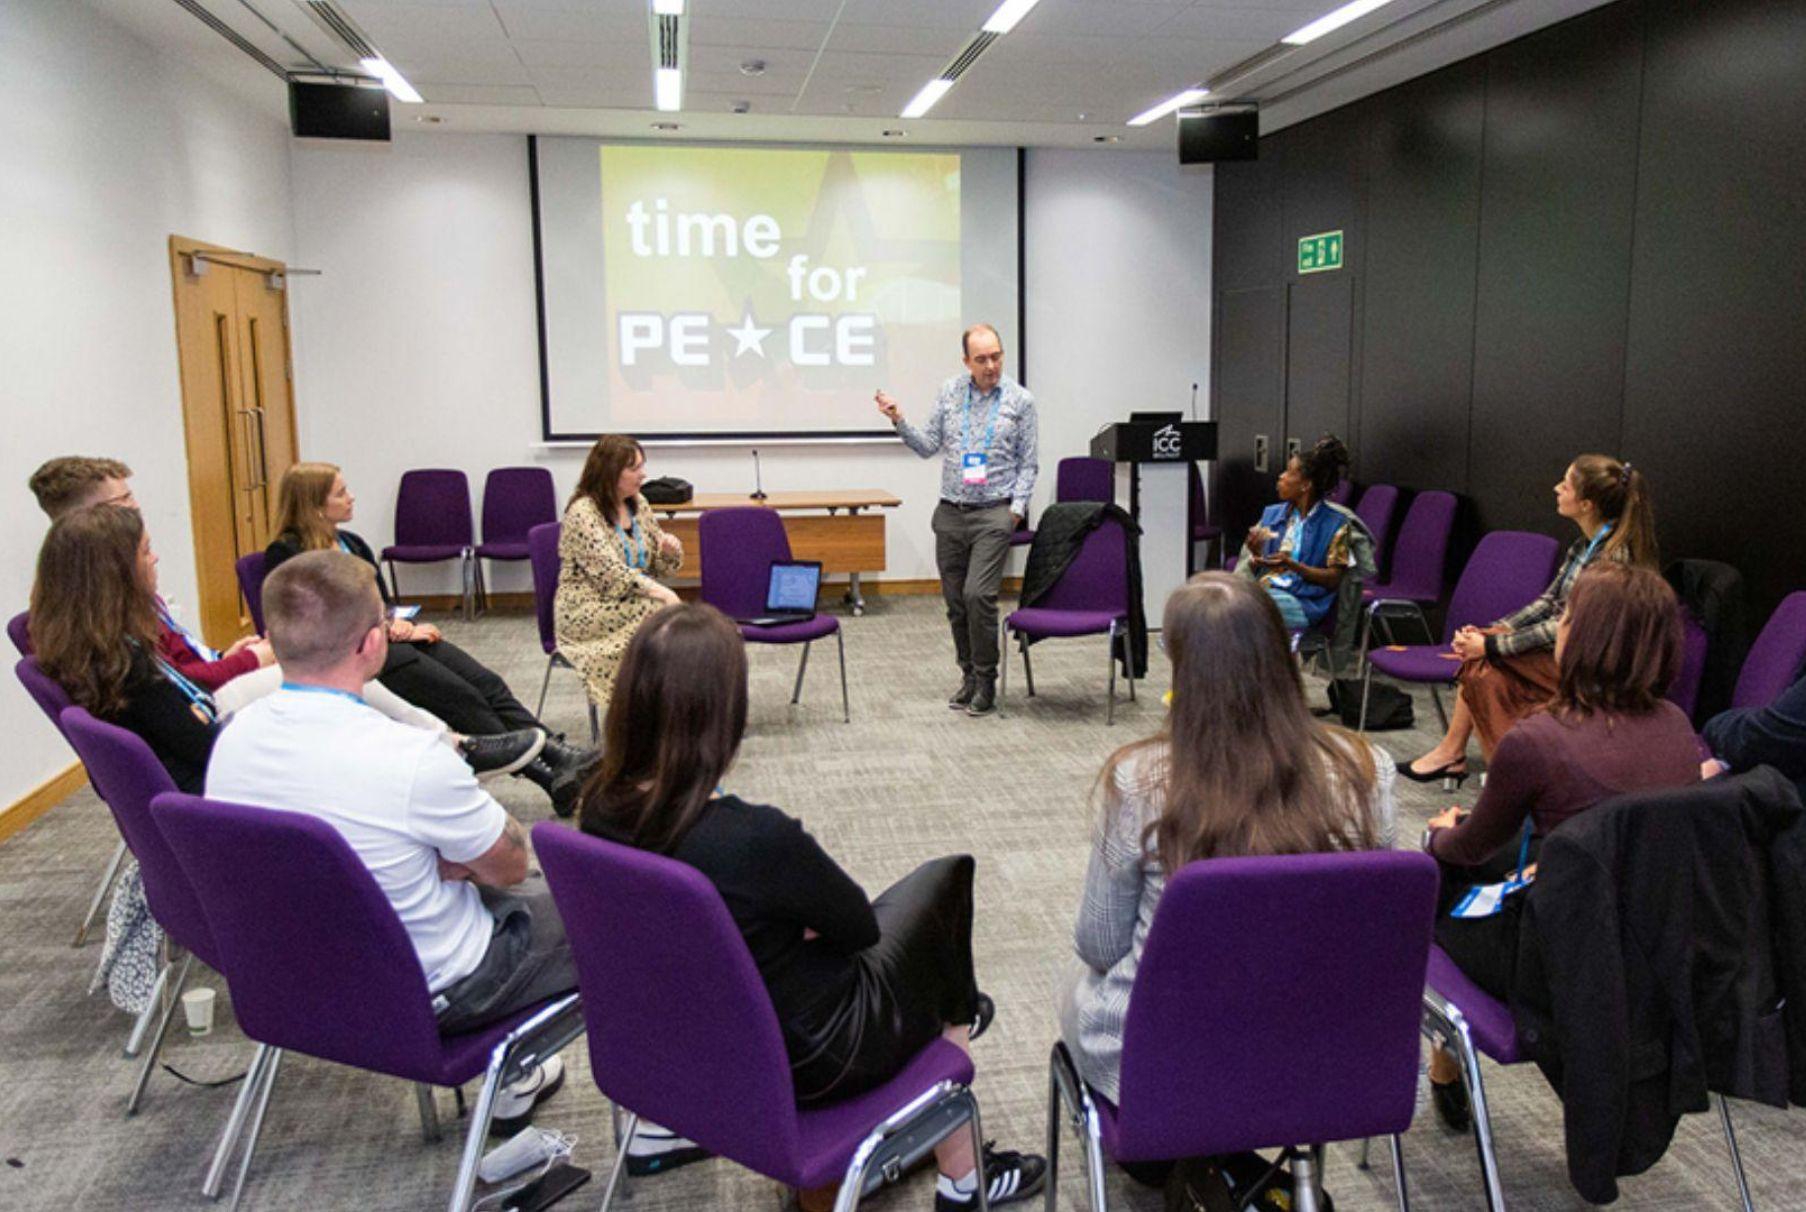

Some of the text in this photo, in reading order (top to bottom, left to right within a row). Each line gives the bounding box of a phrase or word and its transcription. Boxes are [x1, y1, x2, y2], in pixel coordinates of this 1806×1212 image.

[627, 199, 780, 256] time
[787, 255, 866, 300] for
[1153, 437, 1181, 452] ICC
